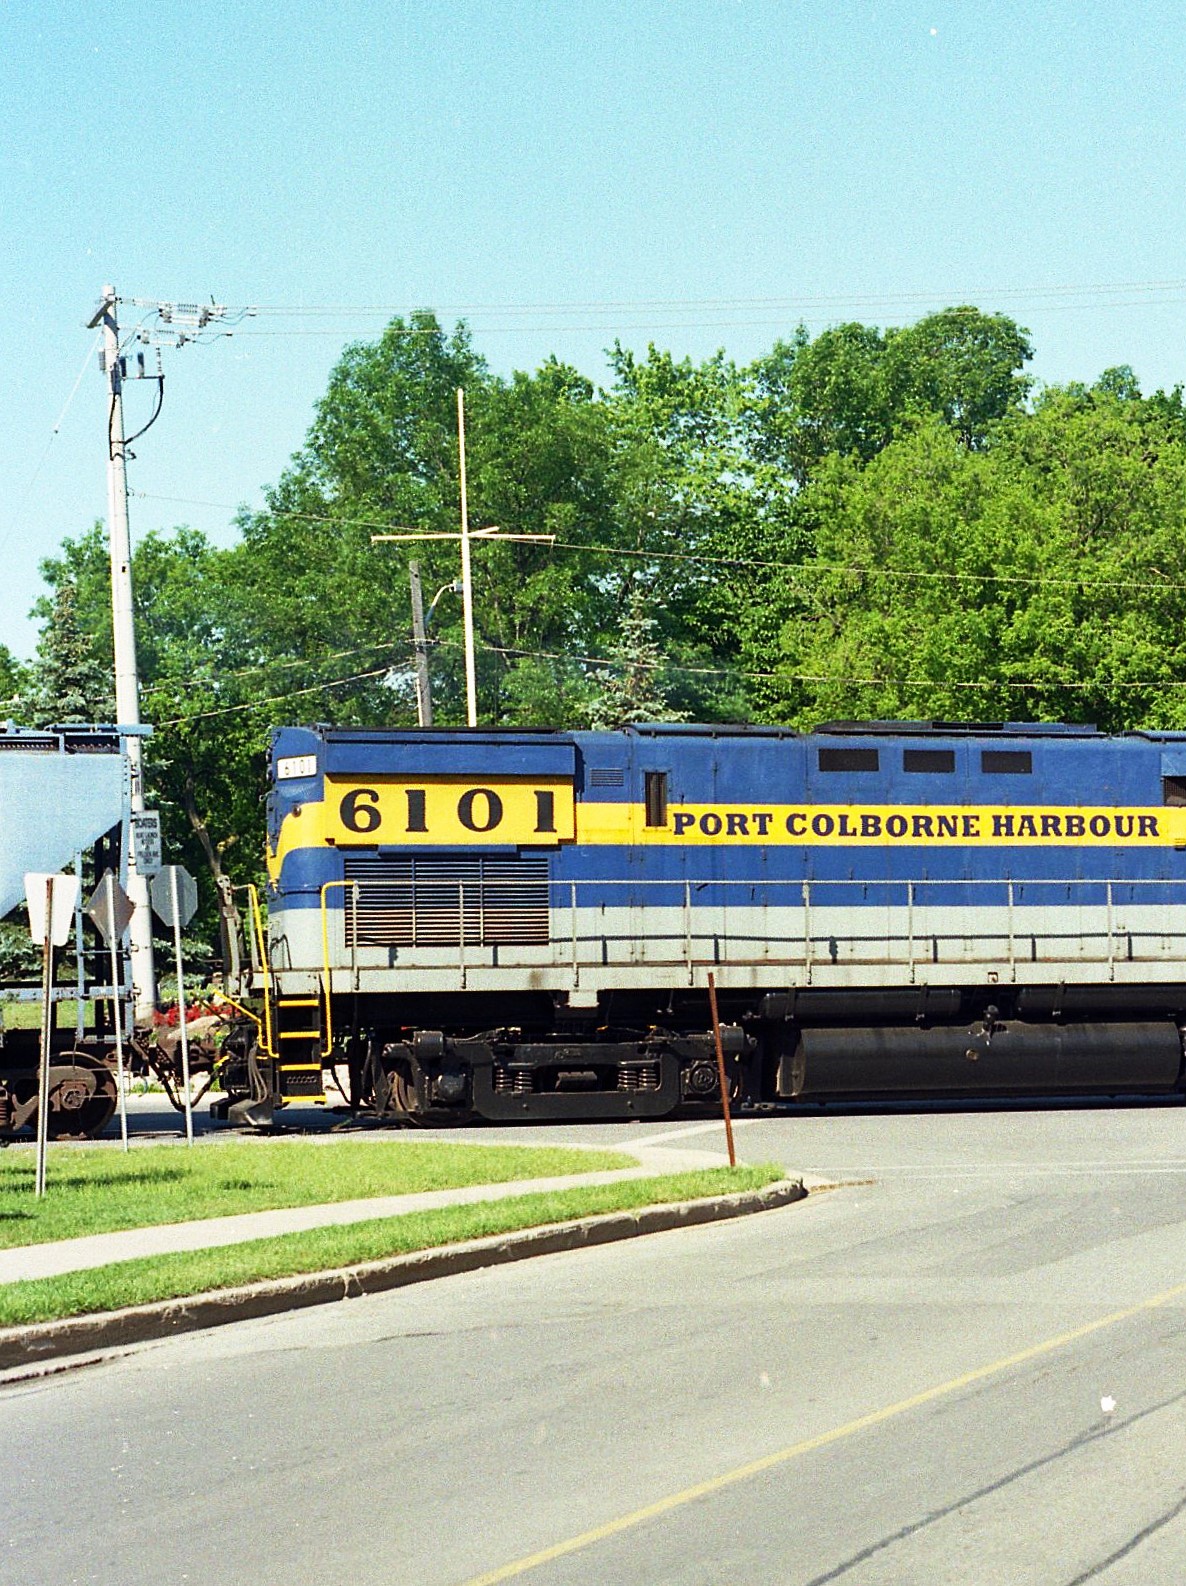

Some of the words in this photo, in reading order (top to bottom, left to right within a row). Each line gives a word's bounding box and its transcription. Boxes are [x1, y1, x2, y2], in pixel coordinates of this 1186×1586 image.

[284, 759, 311, 776] 6101
[339, 788, 558, 833] 6101
[673, 812, 773, 836] PORT
[785, 813, 981, 838] COLBORNE
[992, 814, 1160, 838] HARBOUR
